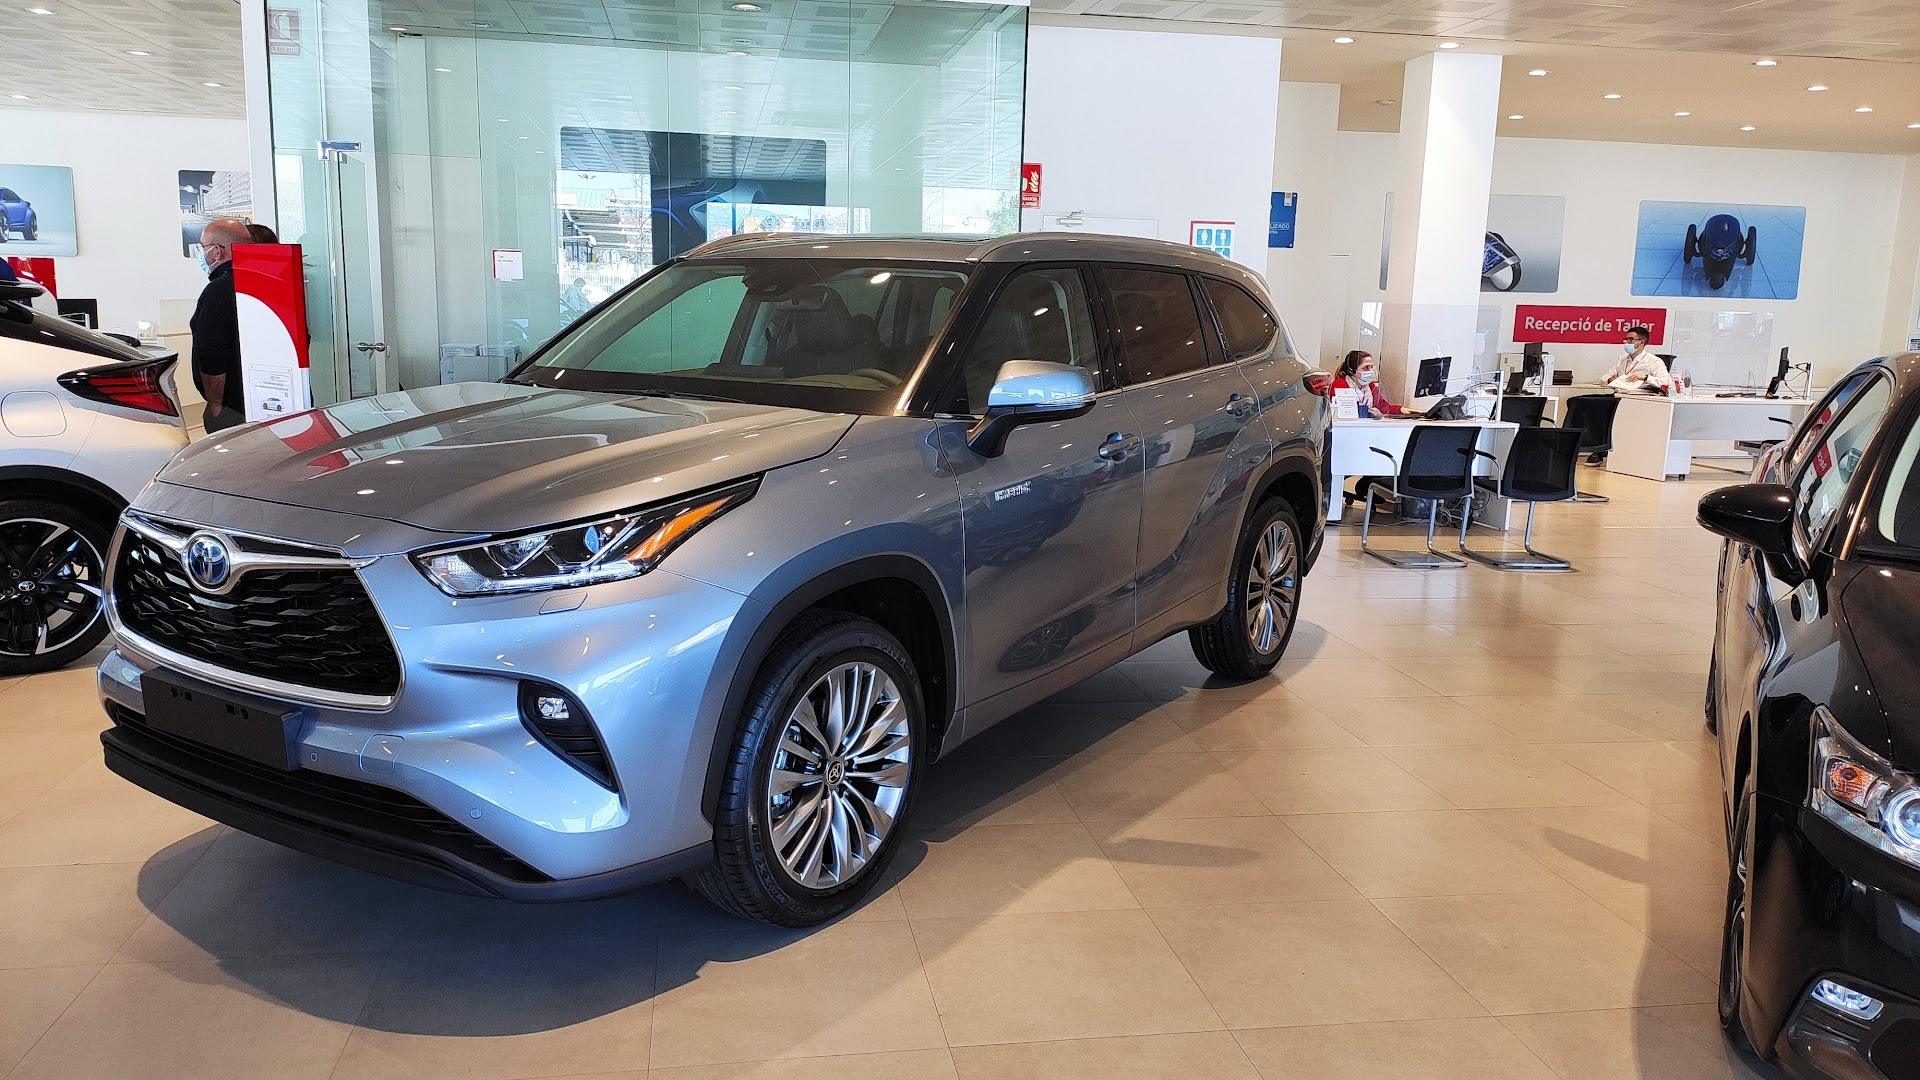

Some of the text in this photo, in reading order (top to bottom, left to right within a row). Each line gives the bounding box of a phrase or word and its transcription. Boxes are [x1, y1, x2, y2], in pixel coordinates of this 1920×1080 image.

[1525, 316, 1656, 334] Recepció de Taller
